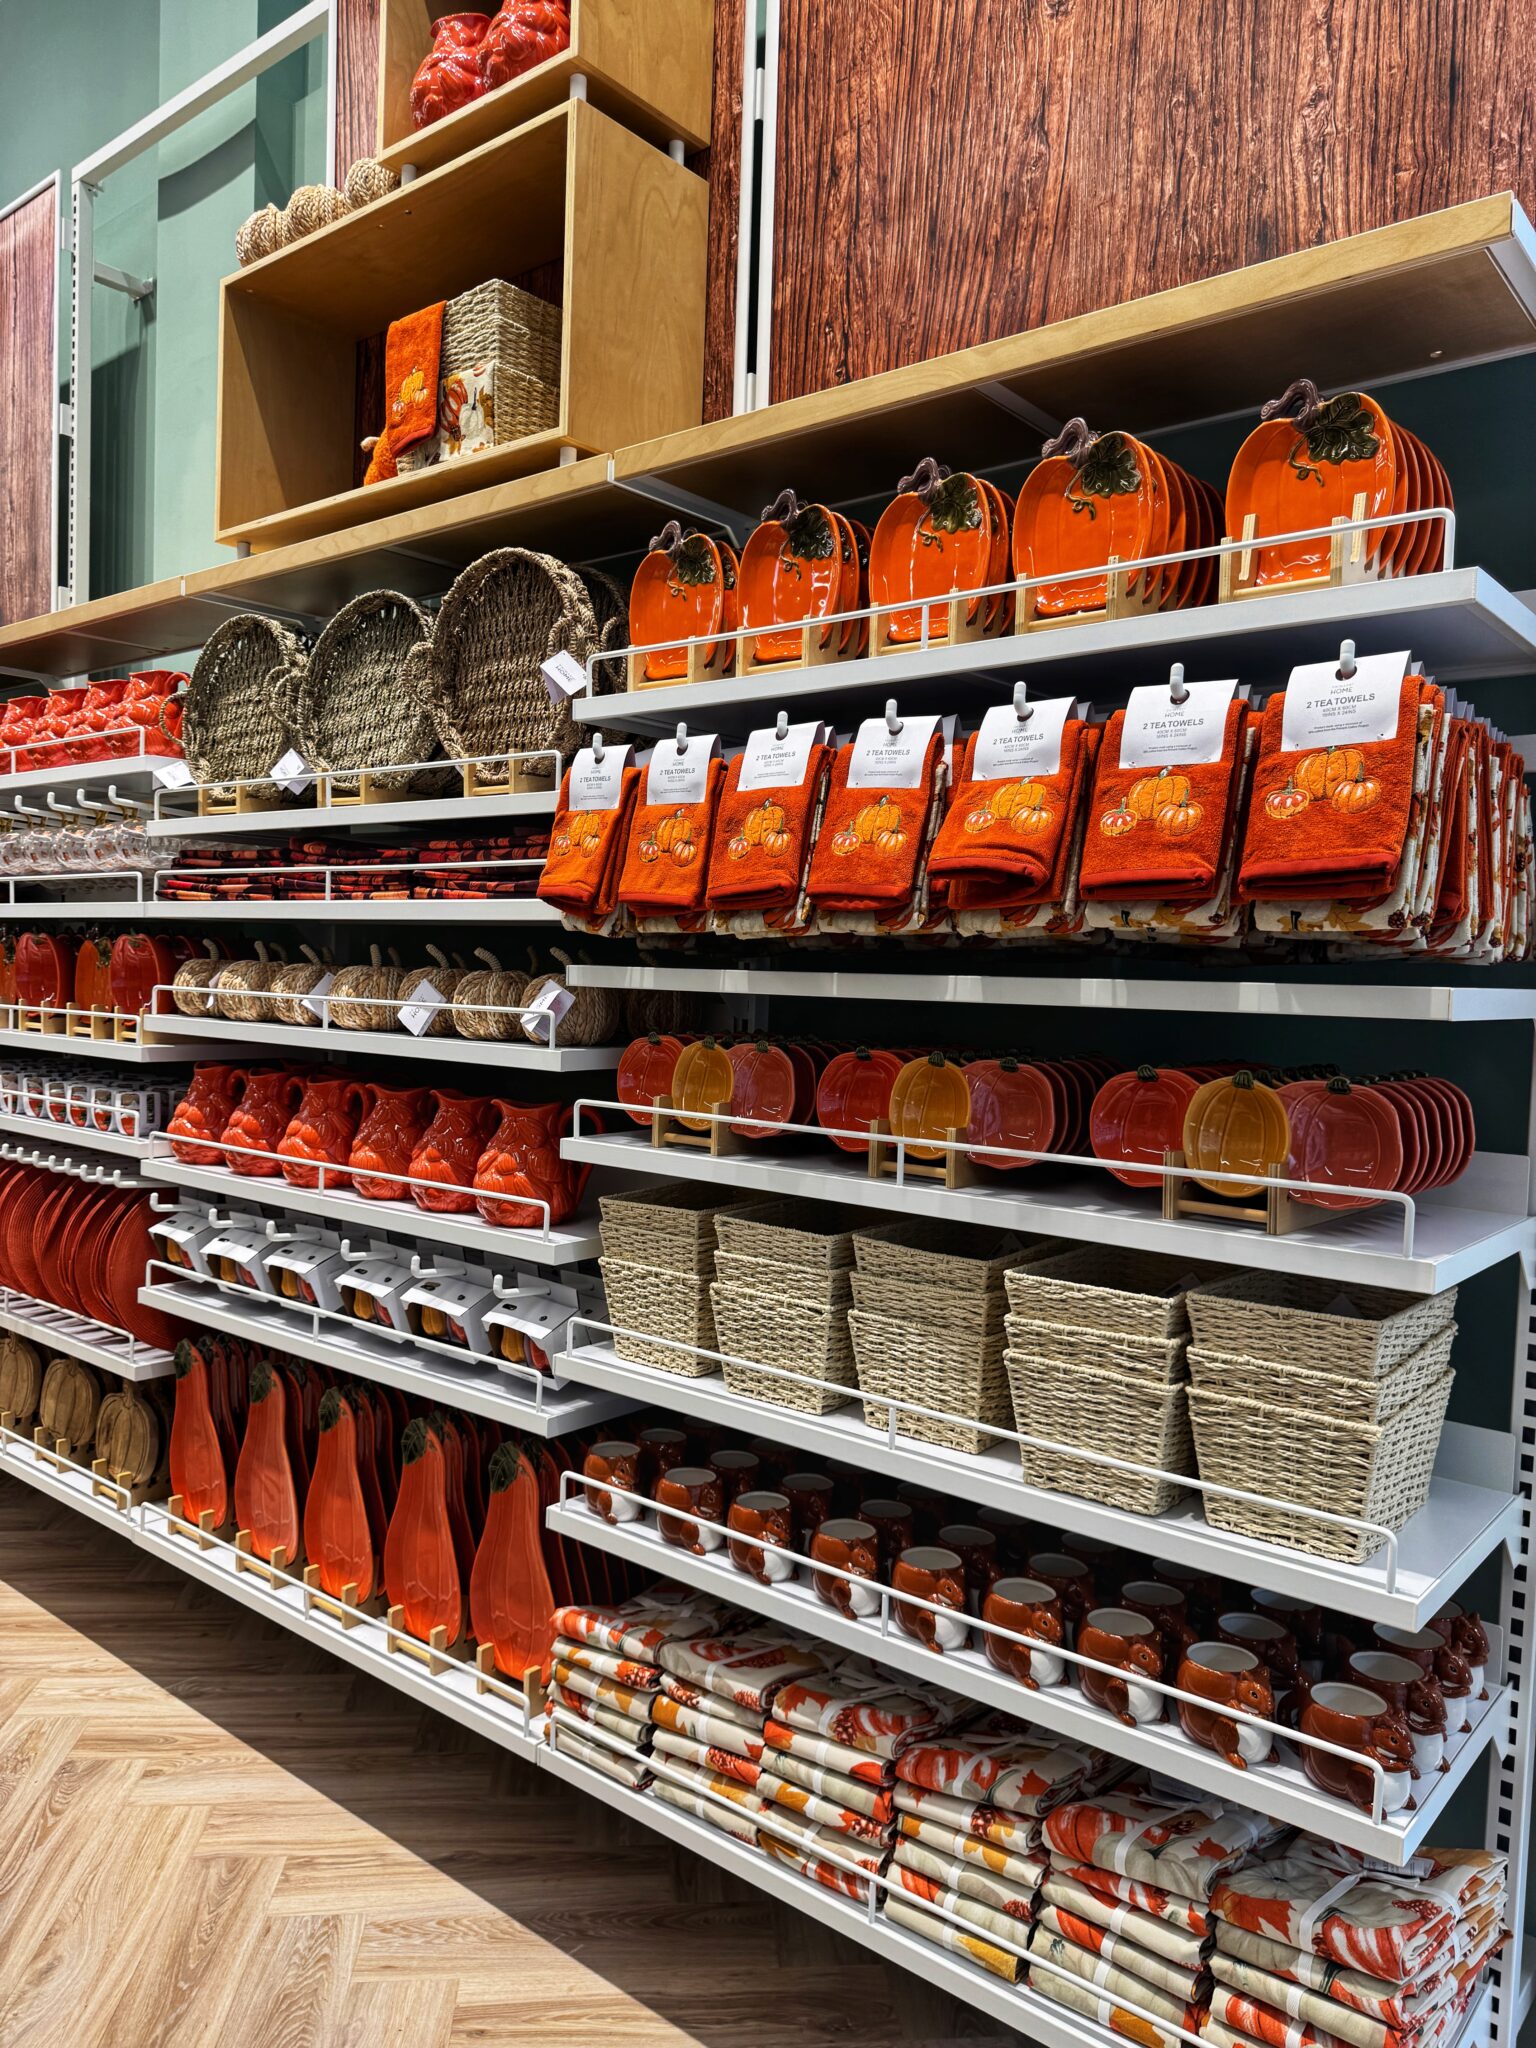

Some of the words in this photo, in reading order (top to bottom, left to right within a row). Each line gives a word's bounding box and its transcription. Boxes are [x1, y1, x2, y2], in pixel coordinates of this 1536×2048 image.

[1331, 687, 1353, 695] HOME
[1315, 699, 1333, 708] TEA
[1335, 693, 1375, 706] TOWELS
[1150, 722, 1167, 730] TEA
[1168, 718, 1204, 728] TOWELS
[999, 737, 1013, 745] TEA
[1014, 733, 1044, 743] TOWELS
